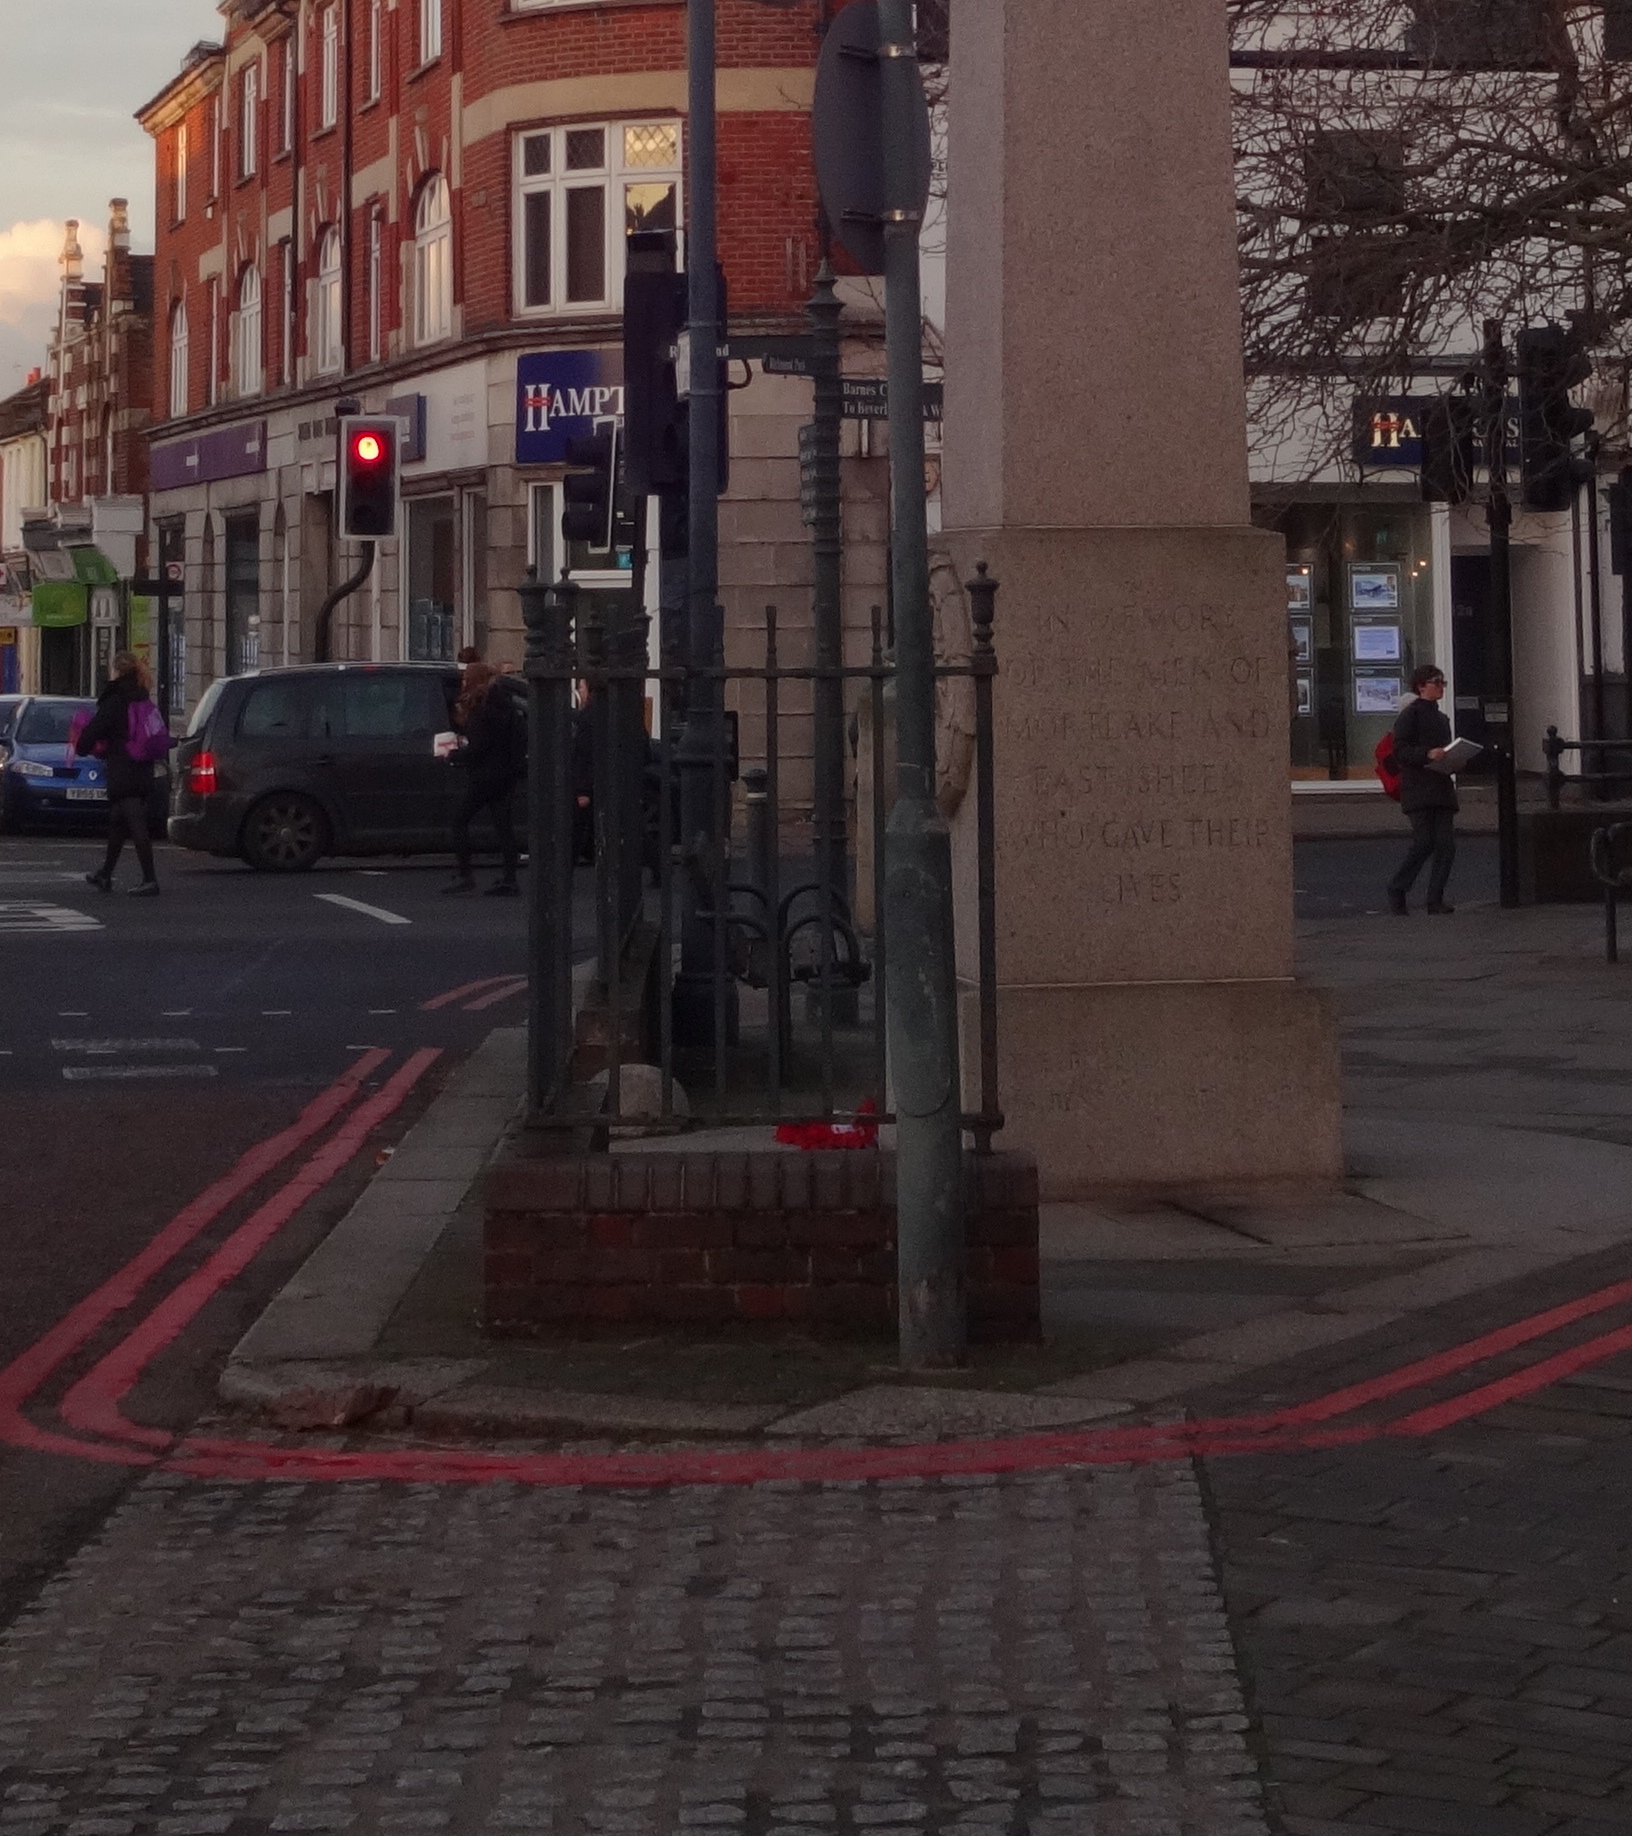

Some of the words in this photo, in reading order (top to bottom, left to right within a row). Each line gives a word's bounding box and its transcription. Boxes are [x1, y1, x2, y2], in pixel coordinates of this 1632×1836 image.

[842, 383, 876, 396] Barnes
[1230, 656, 1268, 684] OF
[1034, 765, 1108, 794] EAST
[1101, 818, 1173, 848] GAVE
[1184, 817, 1270, 847] THEIR
